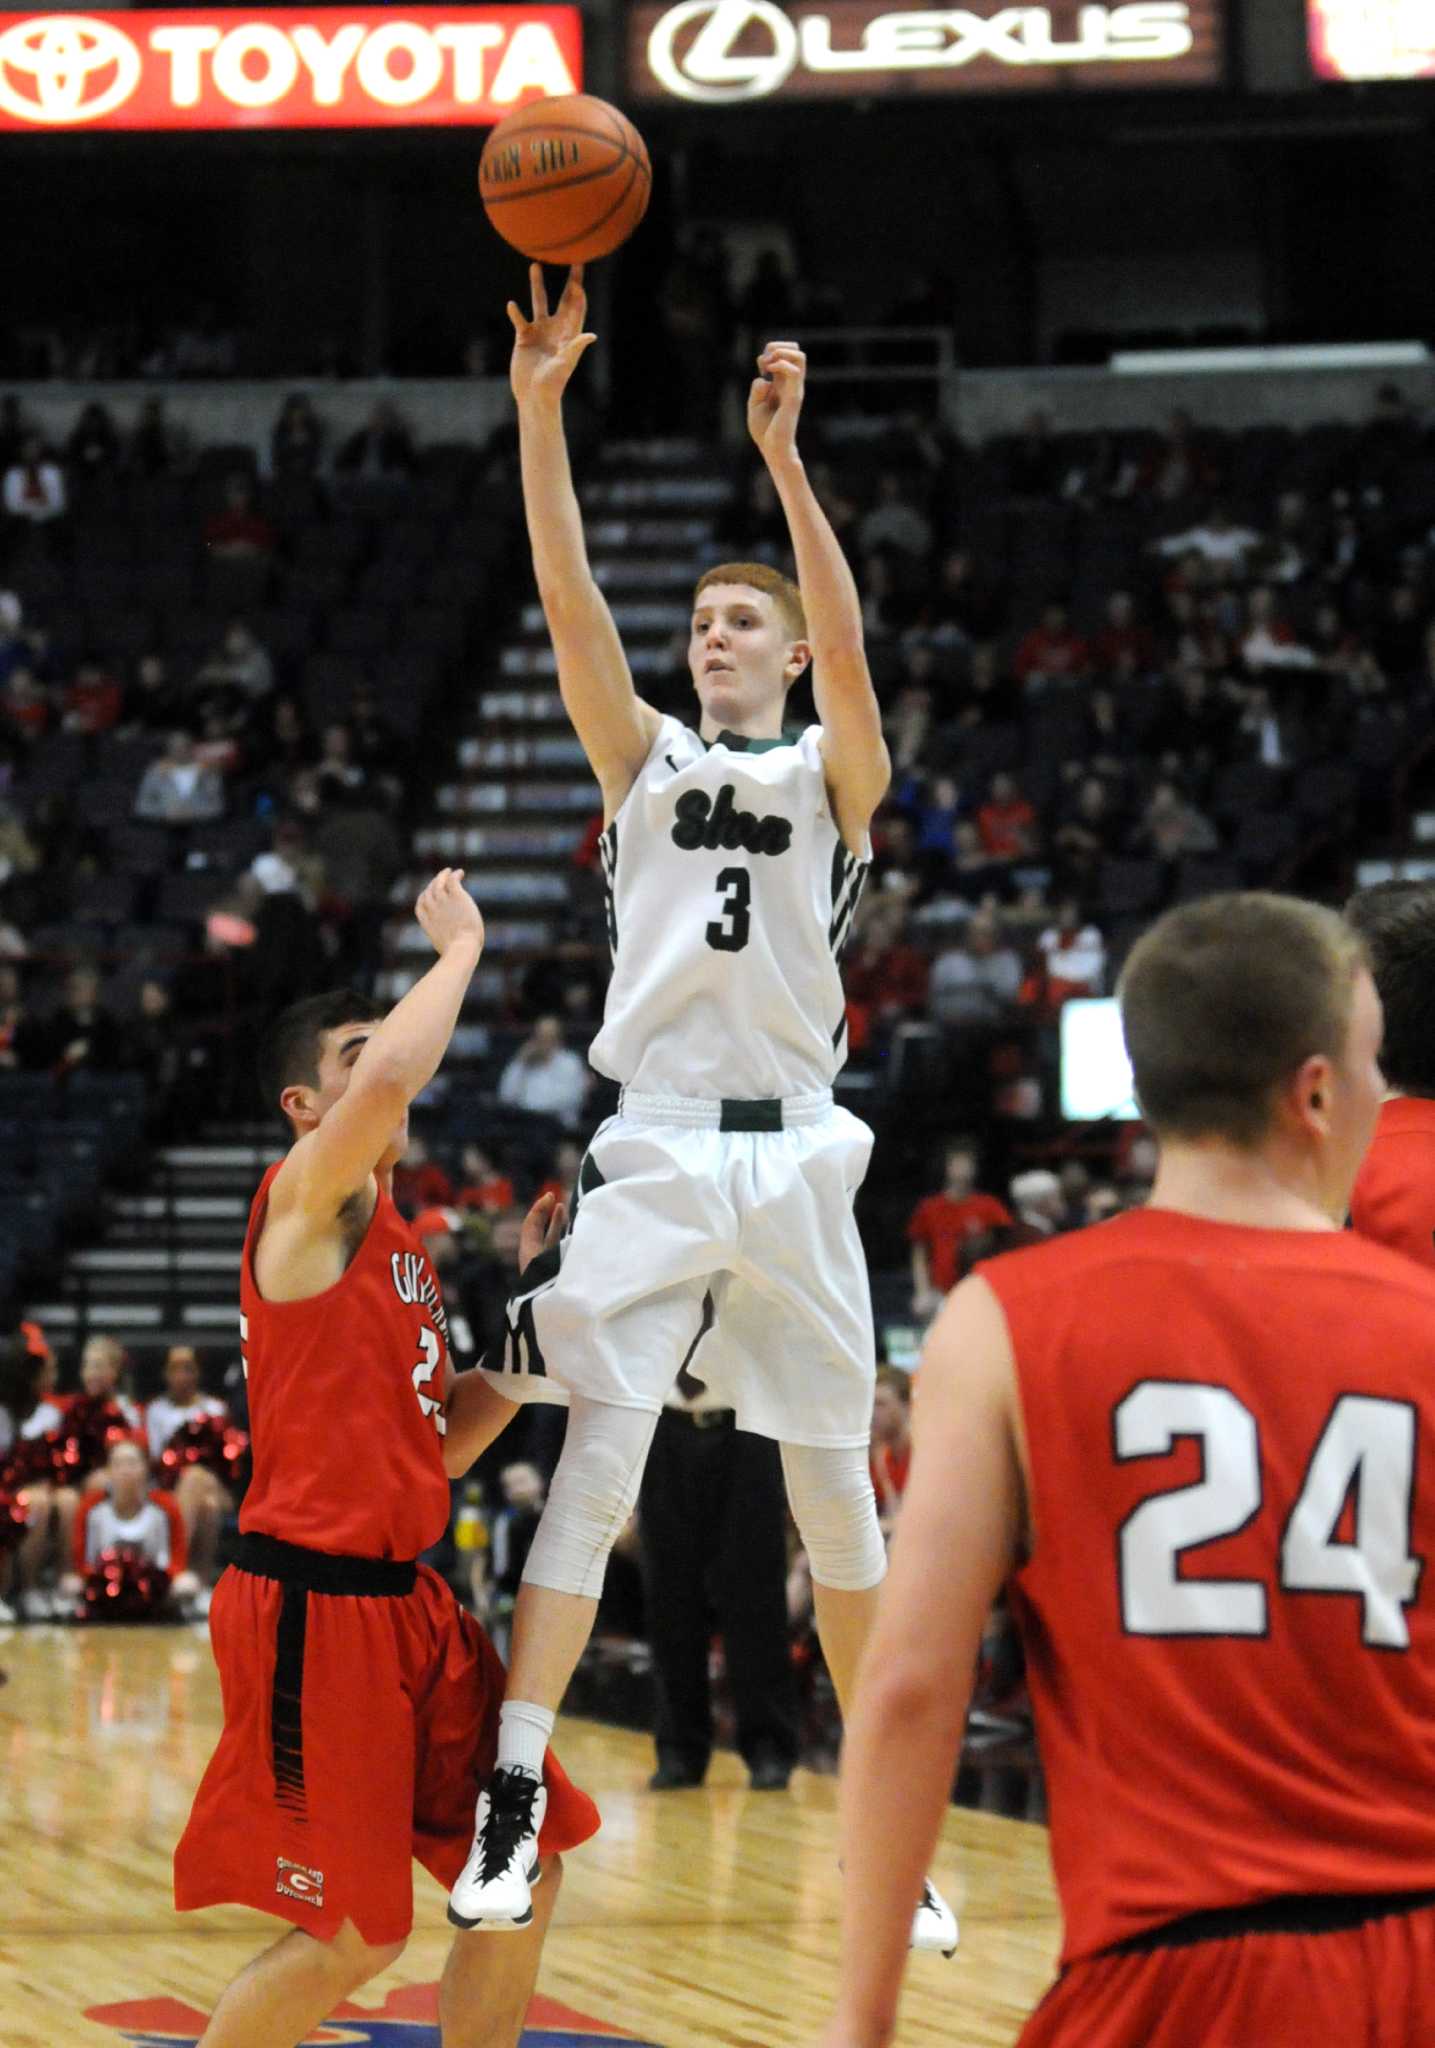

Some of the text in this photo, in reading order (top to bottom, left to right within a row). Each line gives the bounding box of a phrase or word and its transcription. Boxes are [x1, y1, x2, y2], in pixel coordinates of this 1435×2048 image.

[149, 22, 577, 106] TOYOTA
[803, 4, 1193, 70] LEXUS
[705, 867, 751, 953] 3
[1112, 1377, 1424, 1651] 24
